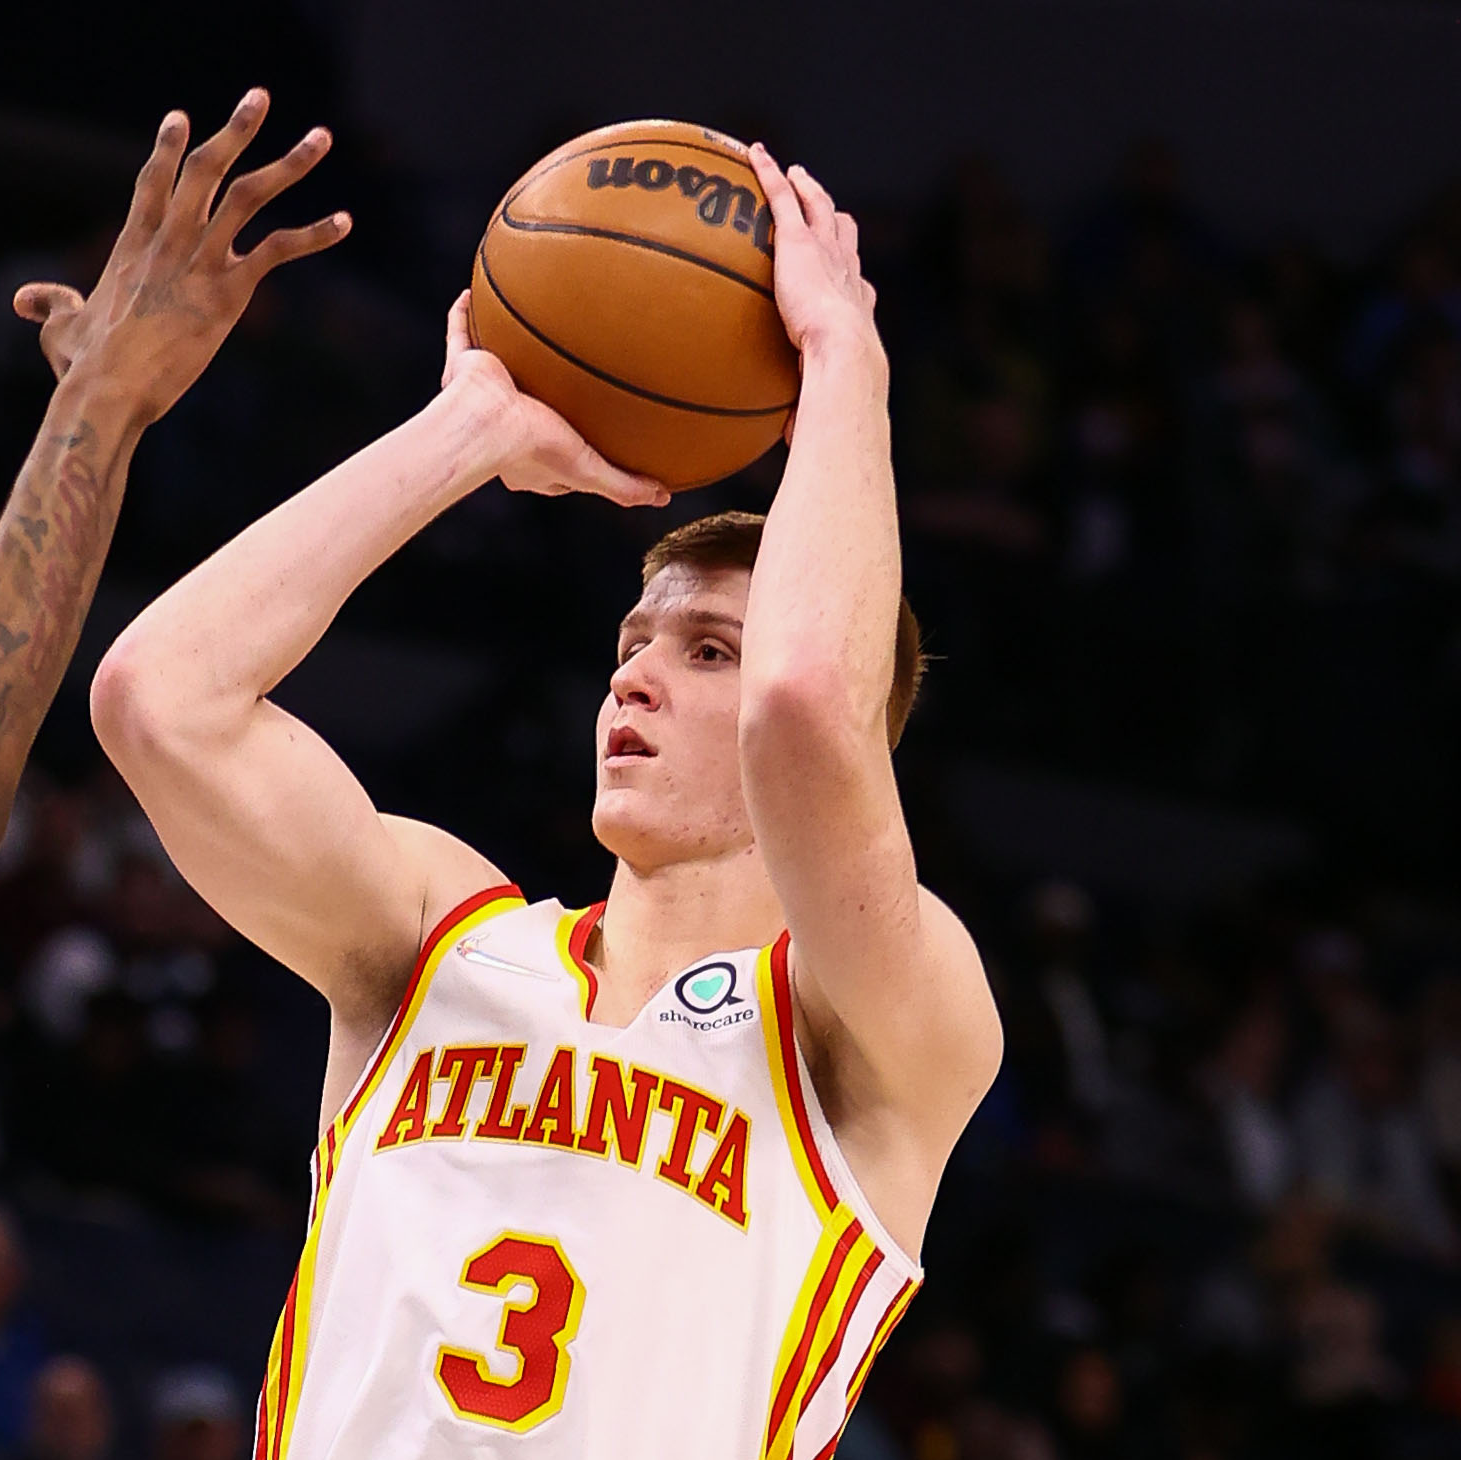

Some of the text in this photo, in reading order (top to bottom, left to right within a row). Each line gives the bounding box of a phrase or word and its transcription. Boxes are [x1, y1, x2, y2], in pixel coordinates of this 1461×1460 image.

[659, 1009, 754, 1031] sharecare
[372, 1039, 753, 1235] ATLANTA
[434, 1230, 587, 1435] 3
